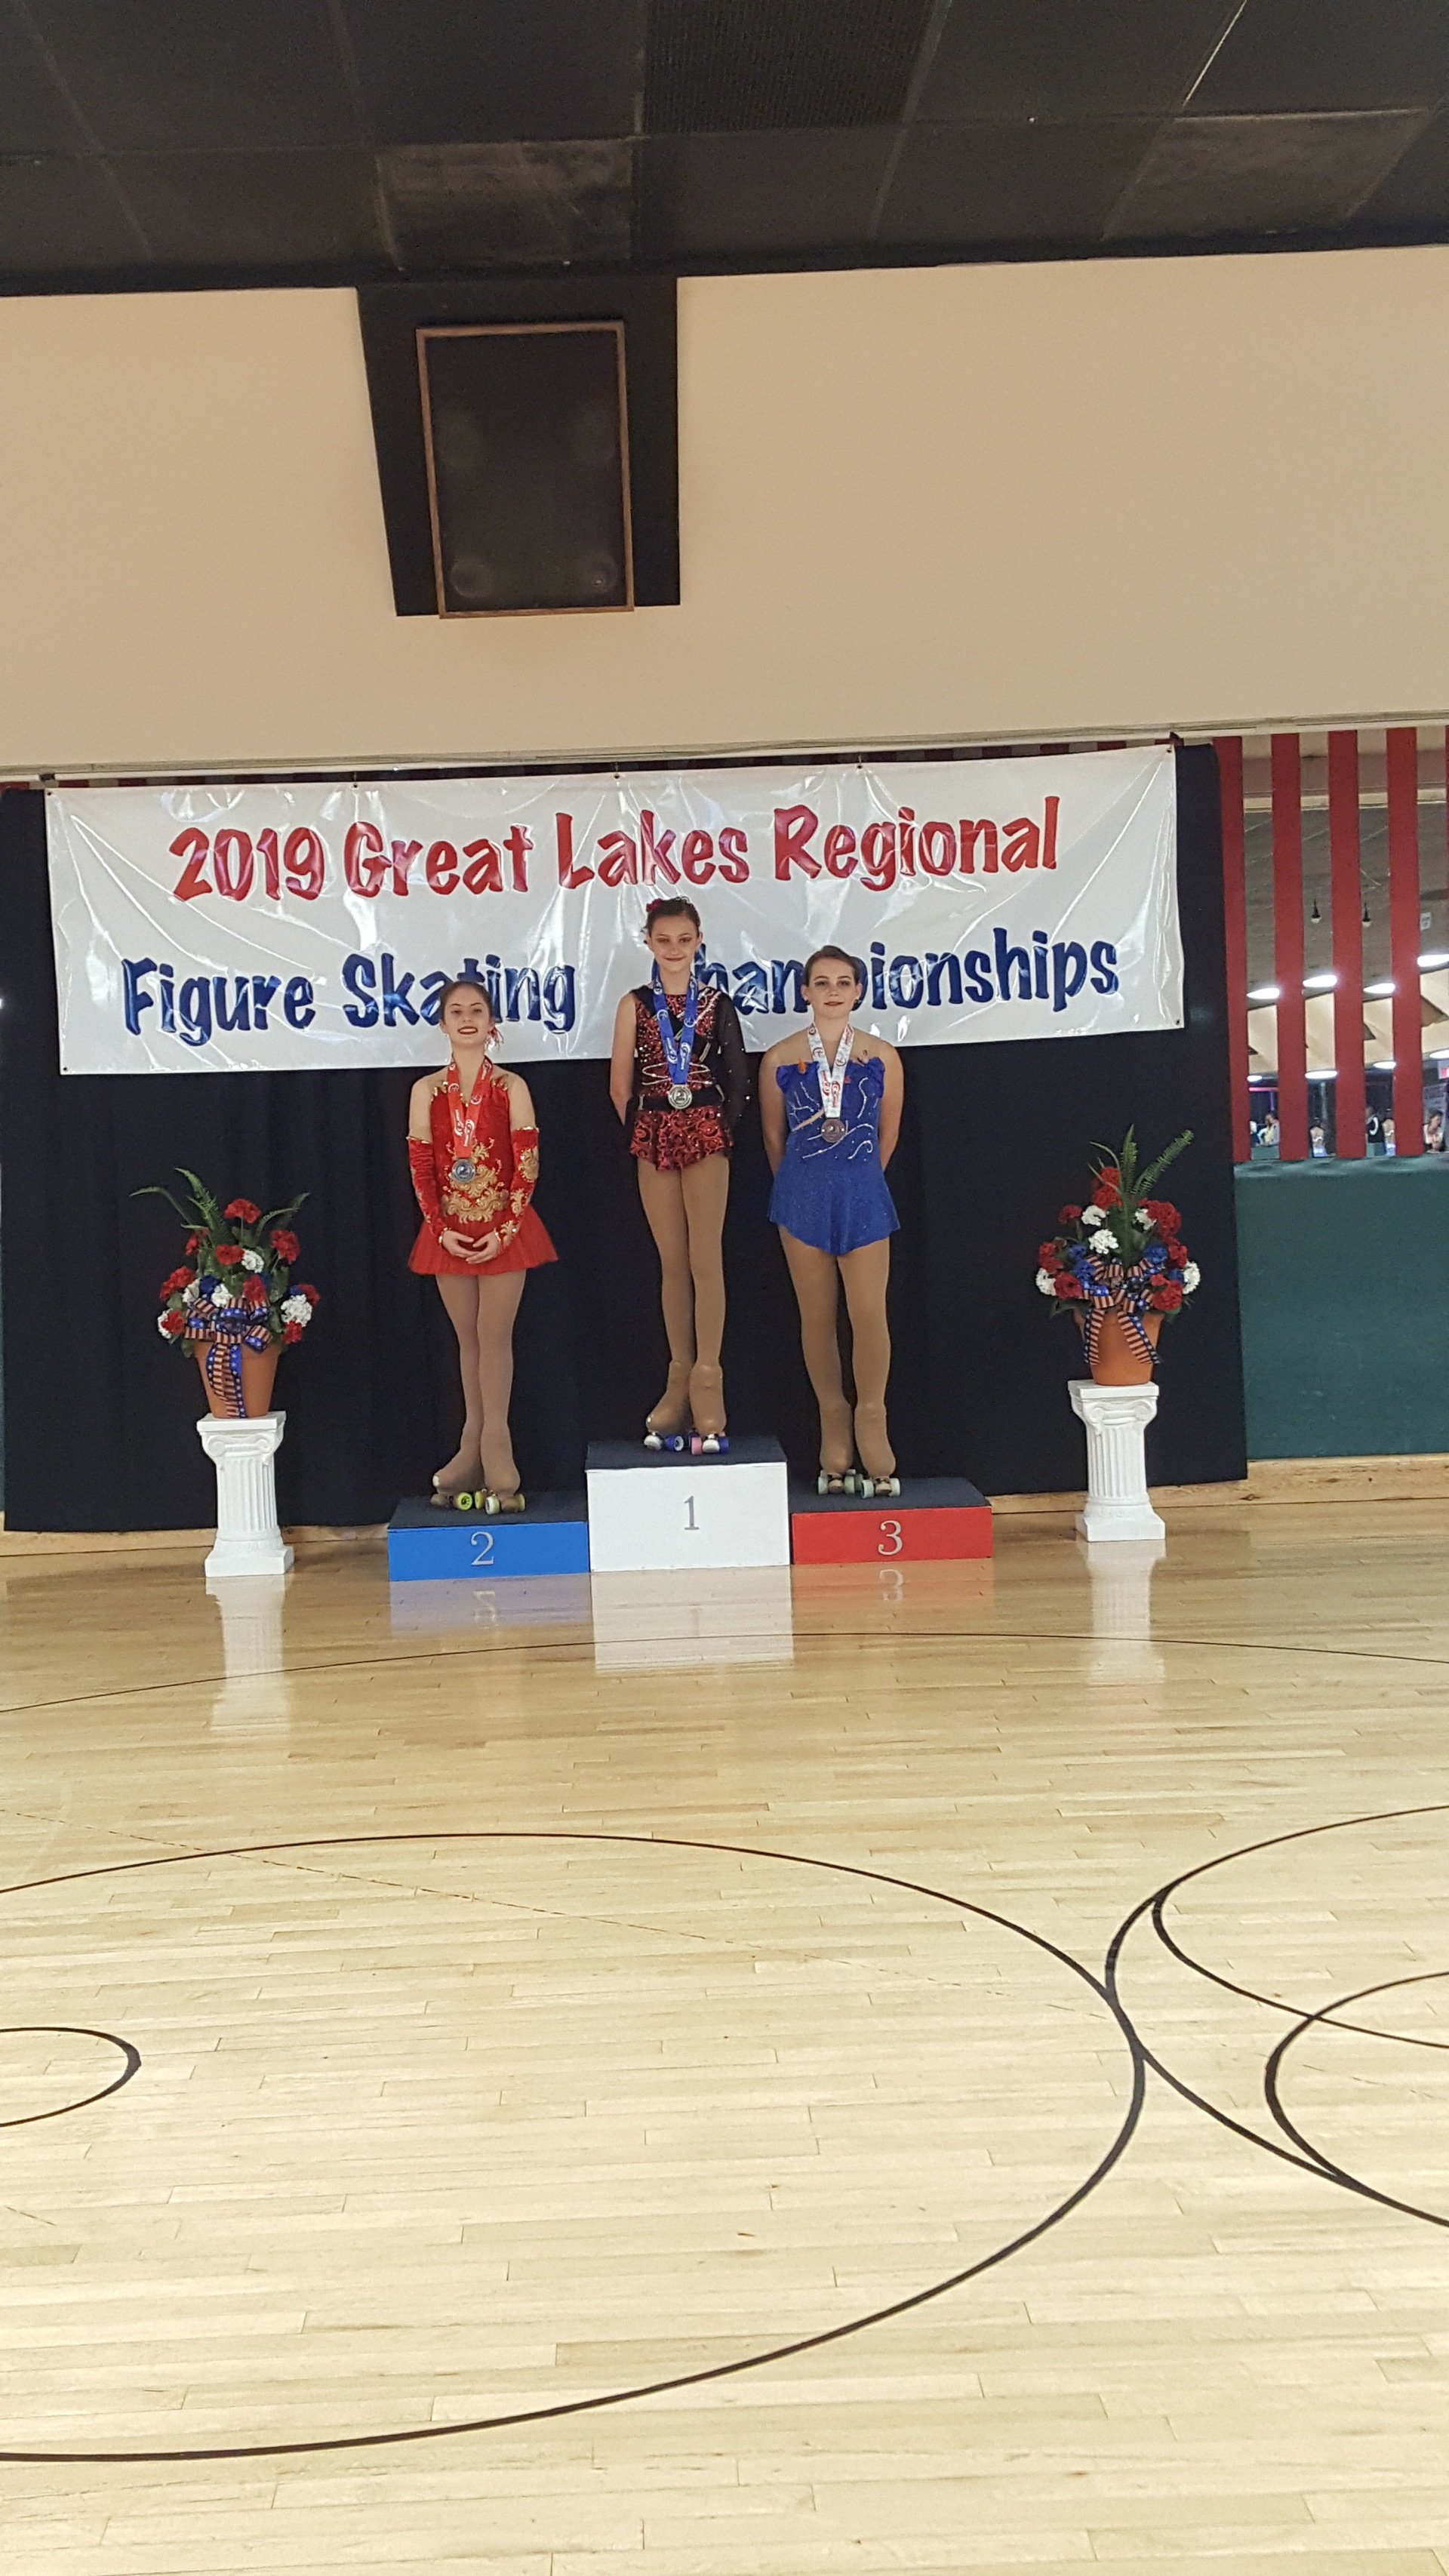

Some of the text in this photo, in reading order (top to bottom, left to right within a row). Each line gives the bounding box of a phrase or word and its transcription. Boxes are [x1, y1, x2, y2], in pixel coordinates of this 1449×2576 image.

[169, 796, 1060, 902] 2019 Great Lakes Regional
[122, 957, 315, 1047] Figure
[694, 927, 1120, 1016] hamionships
[684, 1495, 700, 1531] 1
[470, 1531, 494, 1566] 2
[878, 1519, 903, 1556] 3
